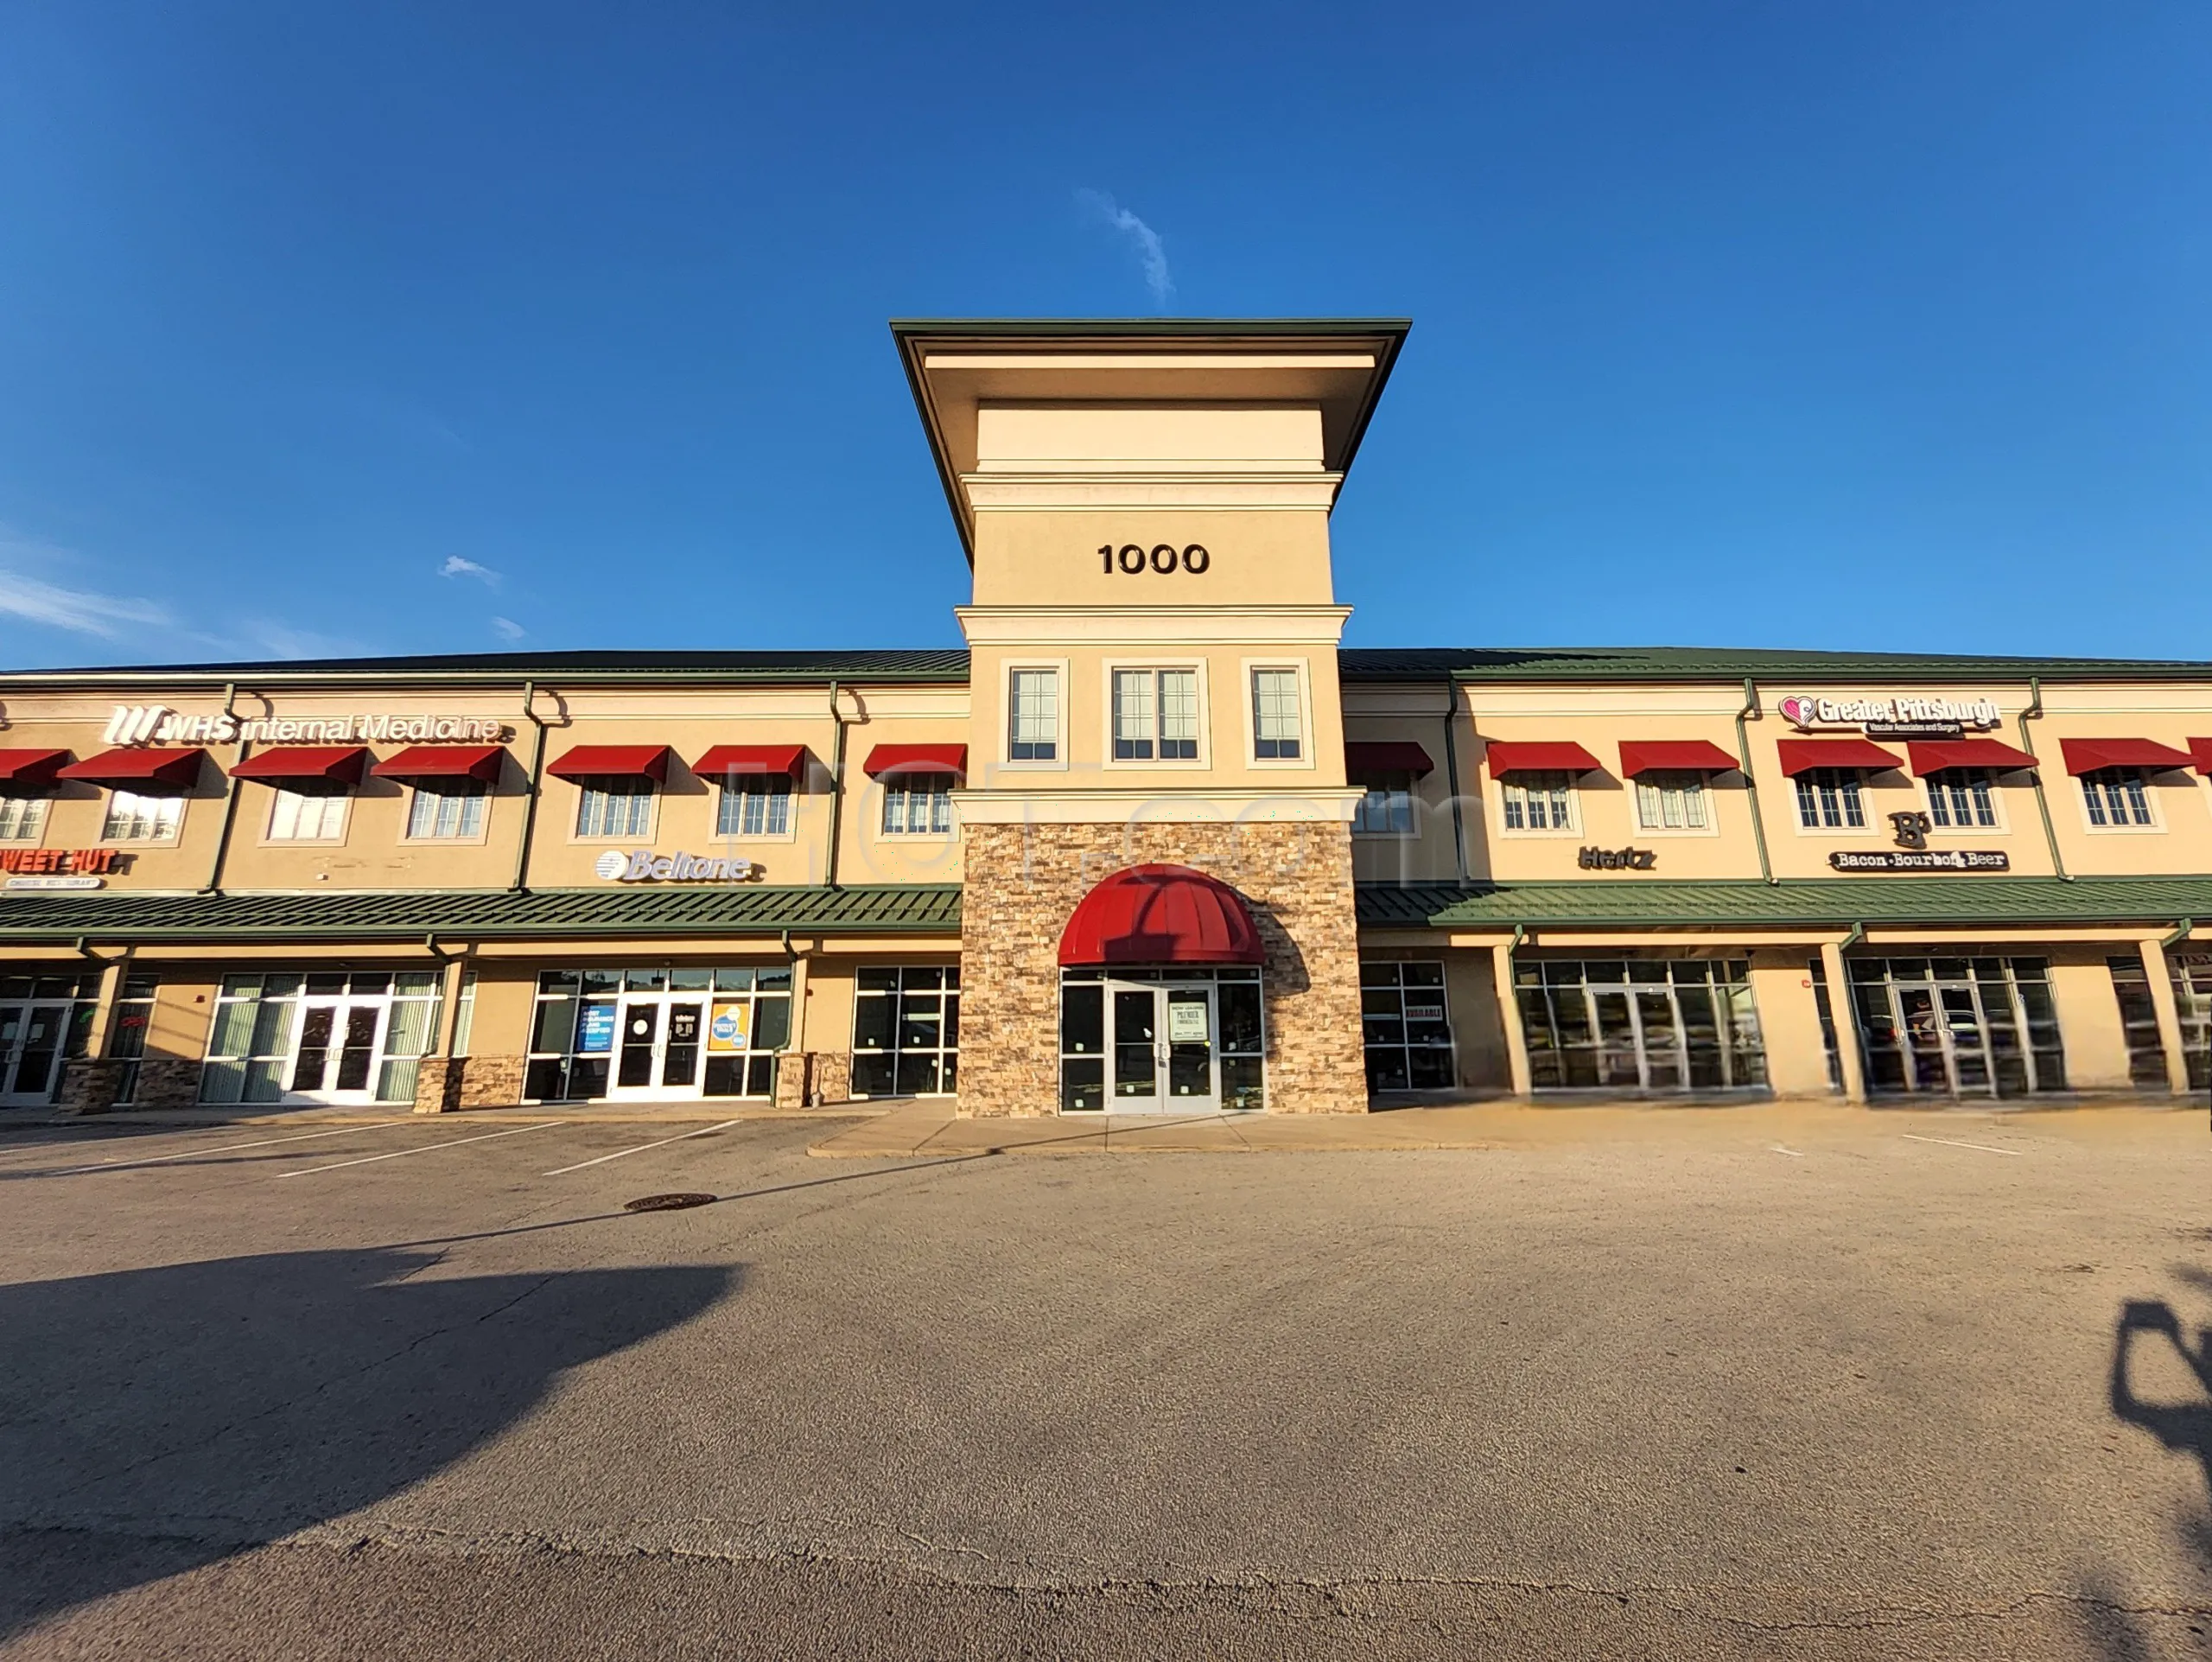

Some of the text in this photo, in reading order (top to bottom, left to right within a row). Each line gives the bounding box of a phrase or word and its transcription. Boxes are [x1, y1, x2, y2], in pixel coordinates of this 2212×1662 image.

[1097, 544, 1211, 575] 1000
[1817, 697, 2002, 725] Greater Pittsburgh
[159, 714, 501, 741] WHS Internal Medicine
[71, 848, 116, 871] HUT
[623, 850, 751, 880] Beltone
[1578, 845, 1657, 870] Hertz
[1837, 852, 1887, 867] Bacon
[1967, 852, 2005, 866] Beer
